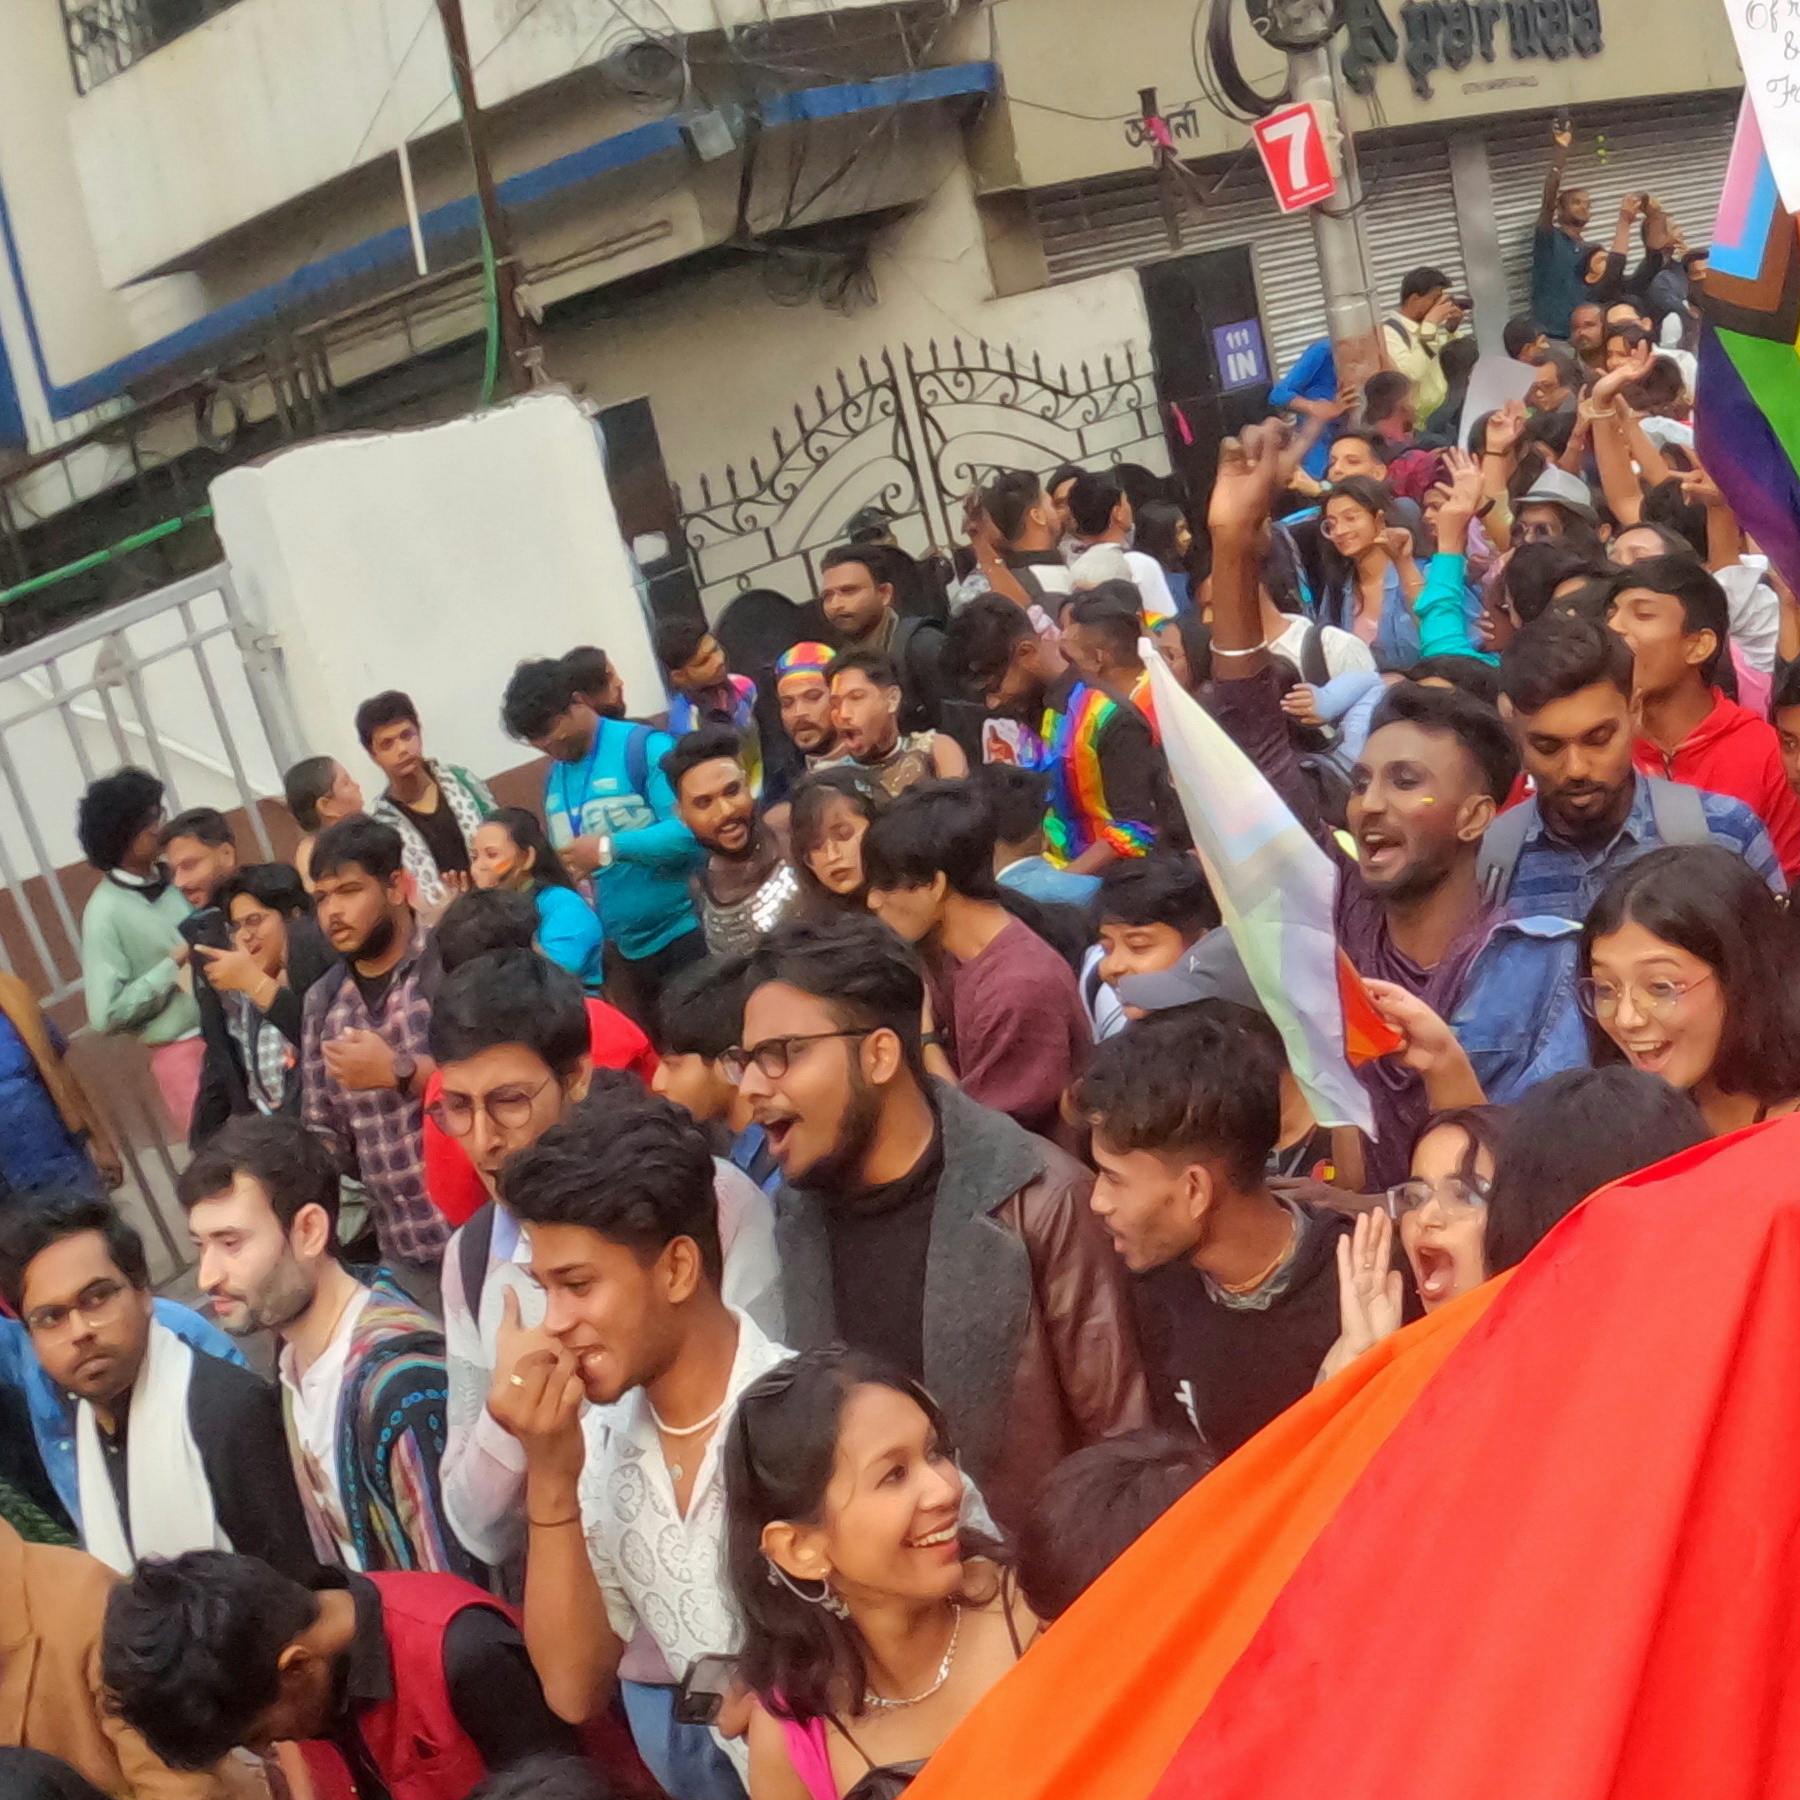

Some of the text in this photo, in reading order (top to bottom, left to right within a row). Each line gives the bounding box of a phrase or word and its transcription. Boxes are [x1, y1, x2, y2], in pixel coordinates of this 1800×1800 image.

[1783, 30, 1800, 61] &
[1262, 112, 1311, 190] 7
[1227, 350, 1258, 382] IN
